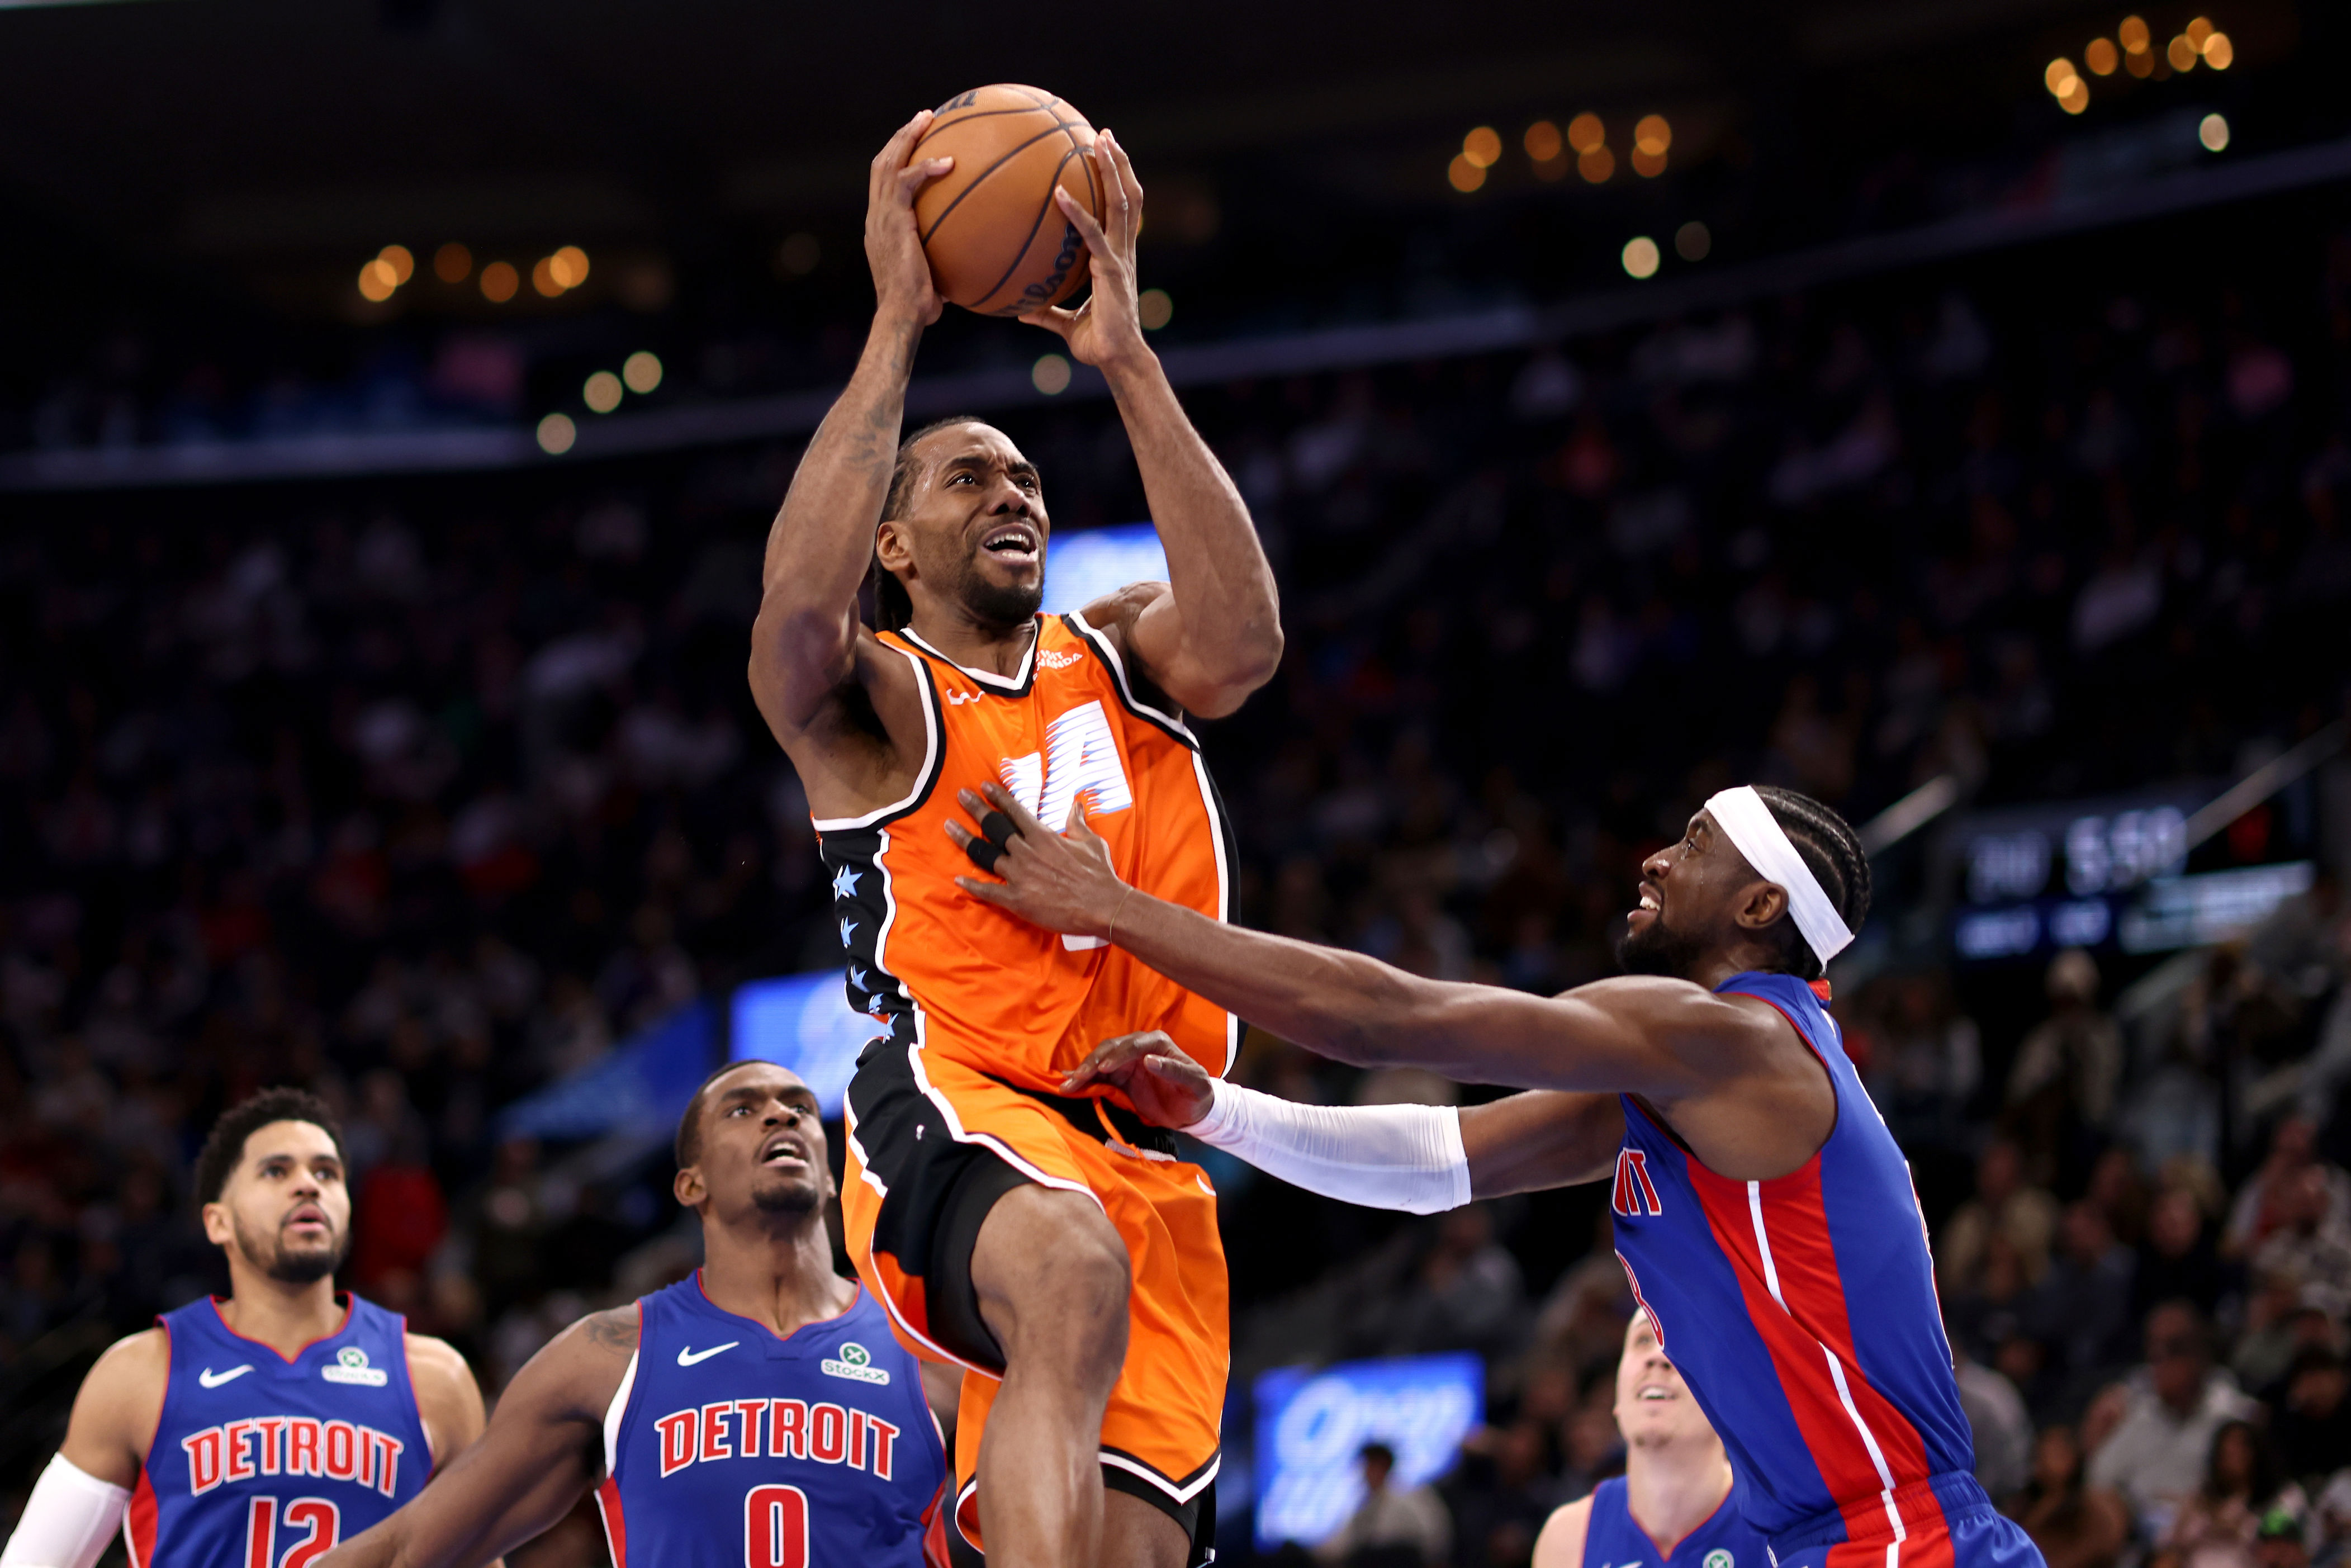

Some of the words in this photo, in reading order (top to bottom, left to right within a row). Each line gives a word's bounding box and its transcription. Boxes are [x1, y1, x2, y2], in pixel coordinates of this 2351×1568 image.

[824, 1361, 886, 1382] StockX
[181, 1415, 404, 1499] DETROIT
[654, 1398, 900, 1481] DETROIT
[244, 1495, 341, 1568] 12
[744, 1483, 810, 1568] 0
